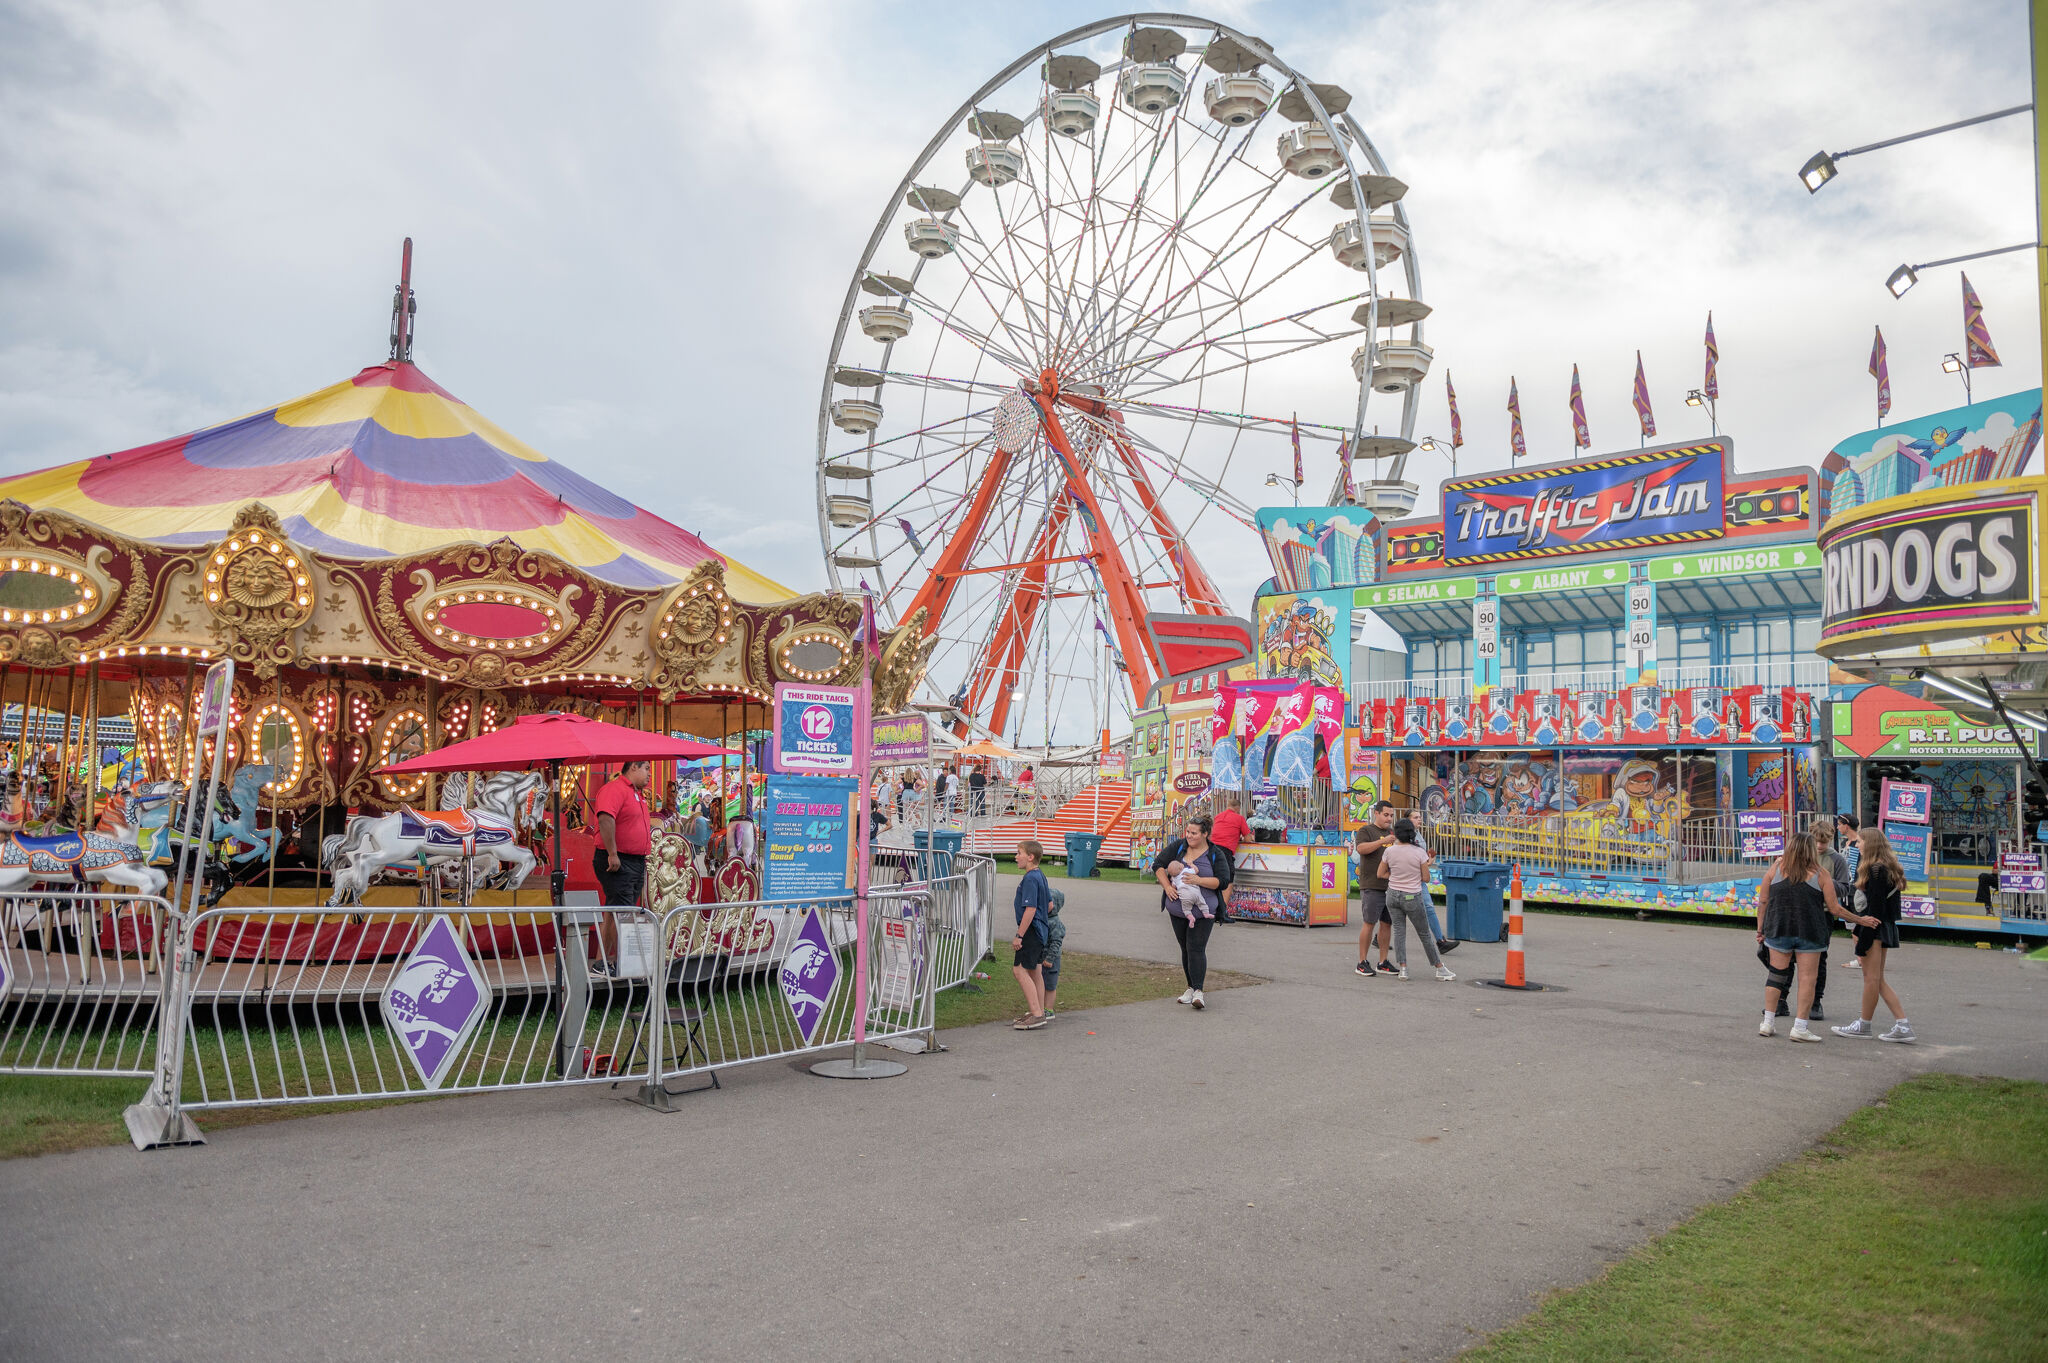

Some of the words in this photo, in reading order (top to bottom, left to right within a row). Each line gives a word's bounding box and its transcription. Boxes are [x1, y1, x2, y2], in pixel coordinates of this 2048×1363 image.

[1455, 485, 1601, 549] Traffic
[1608, 476, 1712, 523] Jam
[1698, 551, 1780, 573] WINDSOR
[1532, 570, 1590, 590] ALBANY
[1388, 584, 1439, 601] SELMA
[1632, 598, 1648, 610] 90
[1480, 612, 1494, 624] 90
[1632, 632, 1649, 644] 40
[1480, 642, 1494, 654] 40
[804, 710, 830, 734] 12
[873, 722, 922, 744] ENTRANCE
[1908, 728, 1952, 743] R.T.
[1958, 728, 2034, 743] PUGH
[797, 741, 837, 752] TICKETS
[1177, 778, 1209, 788] SALOON
[1900, 793, 1915, 805] 12
[776, 803, 806, 816] SIZE
[808, 803, 842, 816] WIZE
[1740, 815, 1756, 824] NO
[770, 844, 792, 853] Merry
[793, 844, 804, 852] Go
